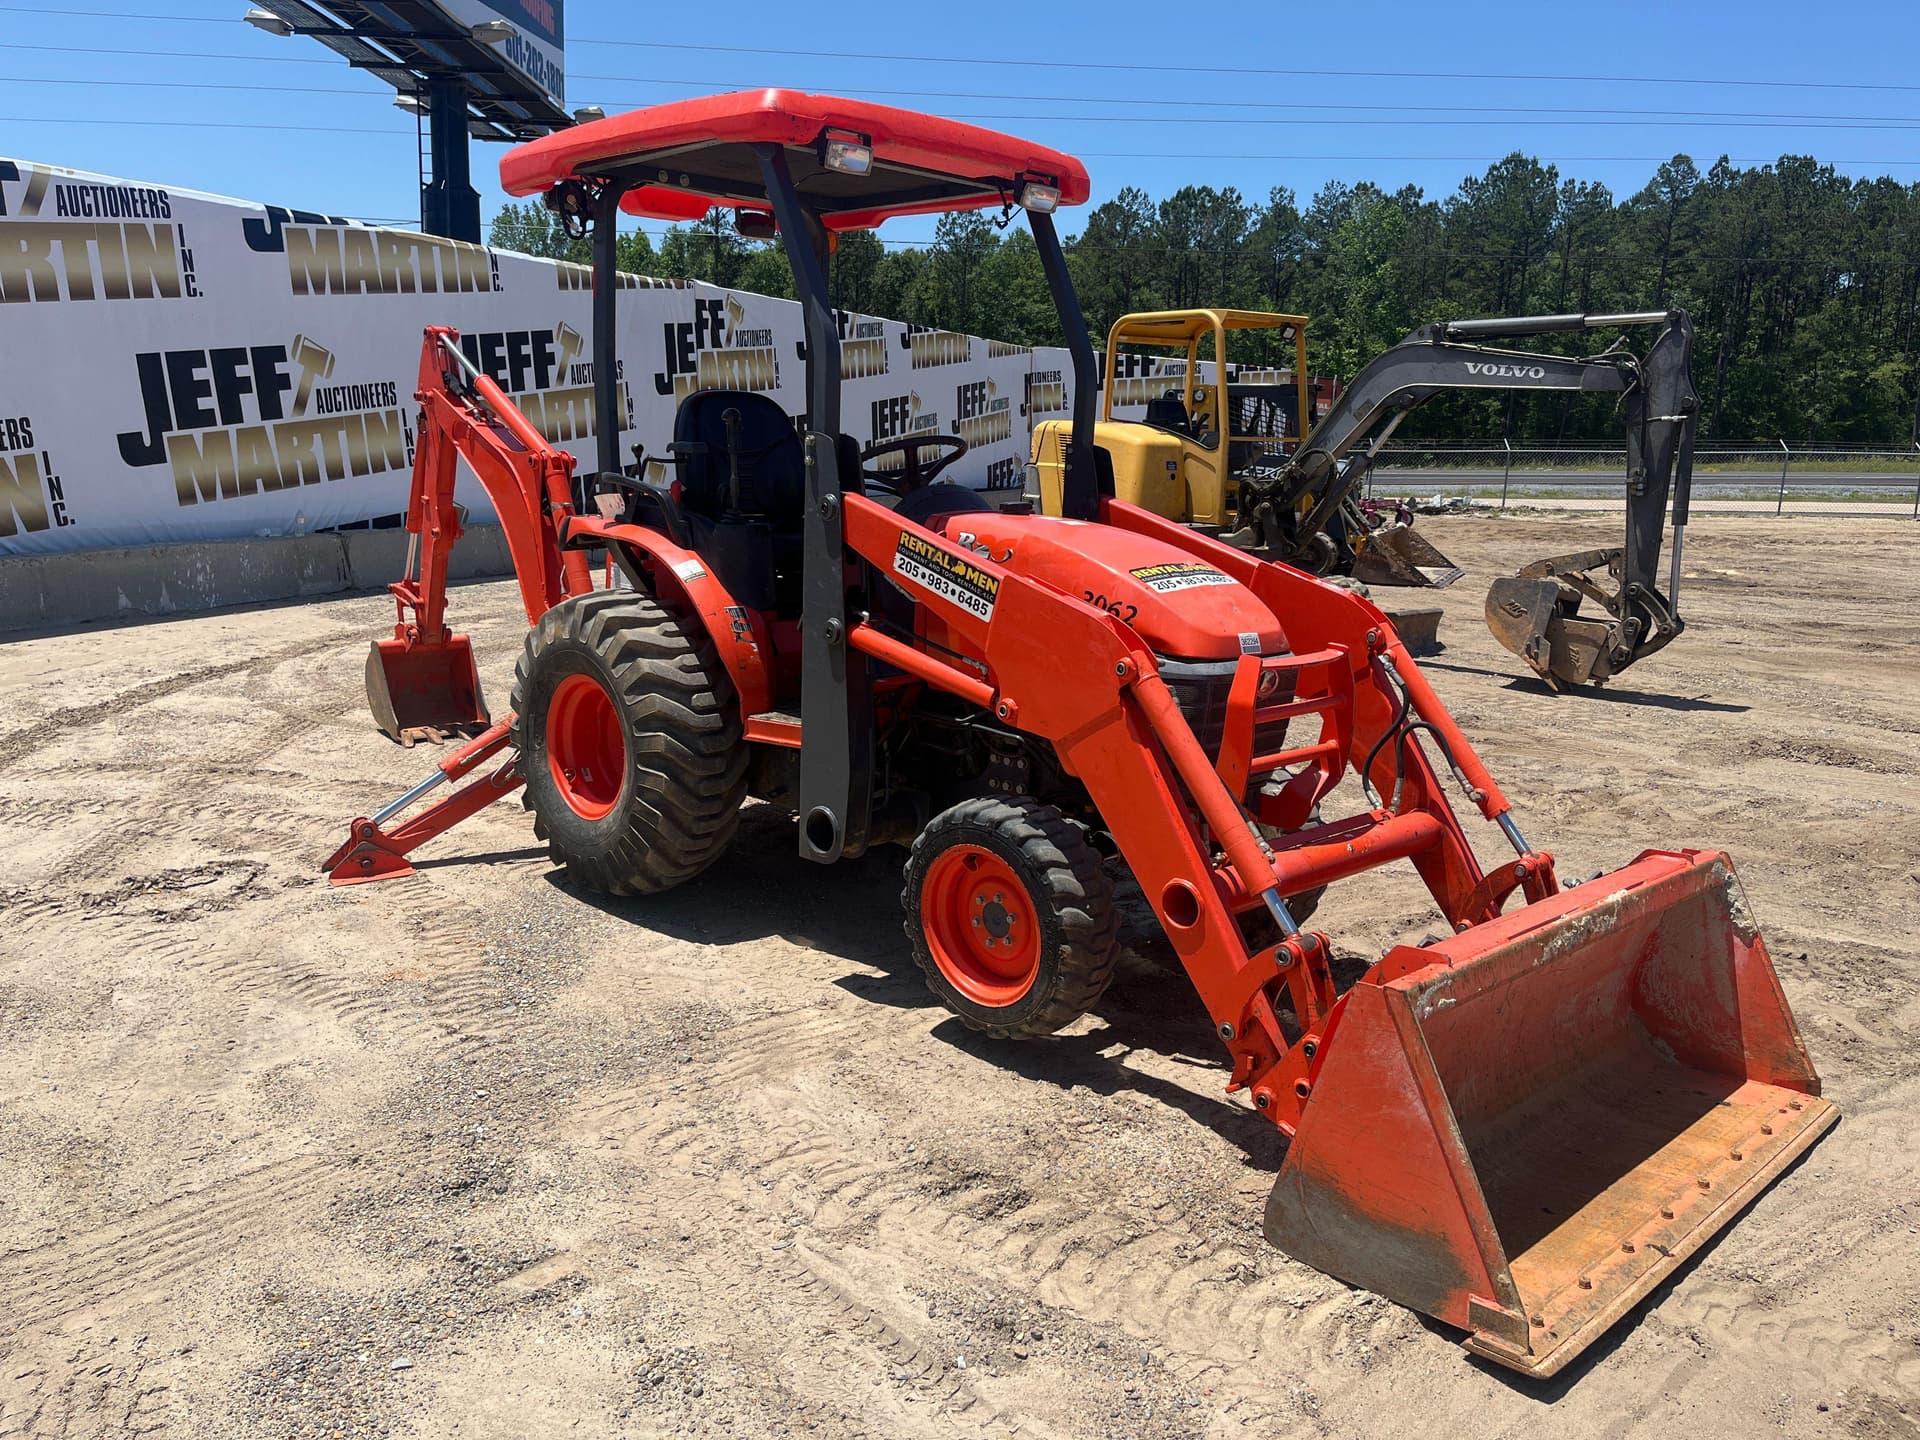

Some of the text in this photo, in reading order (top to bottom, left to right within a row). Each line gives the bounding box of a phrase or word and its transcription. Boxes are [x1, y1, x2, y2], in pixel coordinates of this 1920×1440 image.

[56, 185, 171, 219] AUCTIONEERS
[0, 222, 181, 303] RTIN
[177, 223, 203, 297] INC.
[285, 226, 490, 296] MARTIN
[486, 246, 504, 293] NC.
[655, 299, 725, 395] JEFF
[736, 329, 772, 347] AUCTIONEERS
[841, 339, 884, 380] RTIN
[1031, 371, 1061, 383] TIONEERS
[1464, 362, 1545, 379] VOLVO
[117, 345, 291, 467] JEFF
[316, 381, 397, 415] AUCTIONEERS
[625, 382, 637, 429] INC.
[952, 381, 986, 434] JEFF
[167, 409, 405, 507] MARTIN
[402, 408, 415, 467] INC
[42, 450, 75, 525] INC.
[900, 531, 998, 594] RENTAL MEN
[1130, 565, 1181, 578] RENTAL
